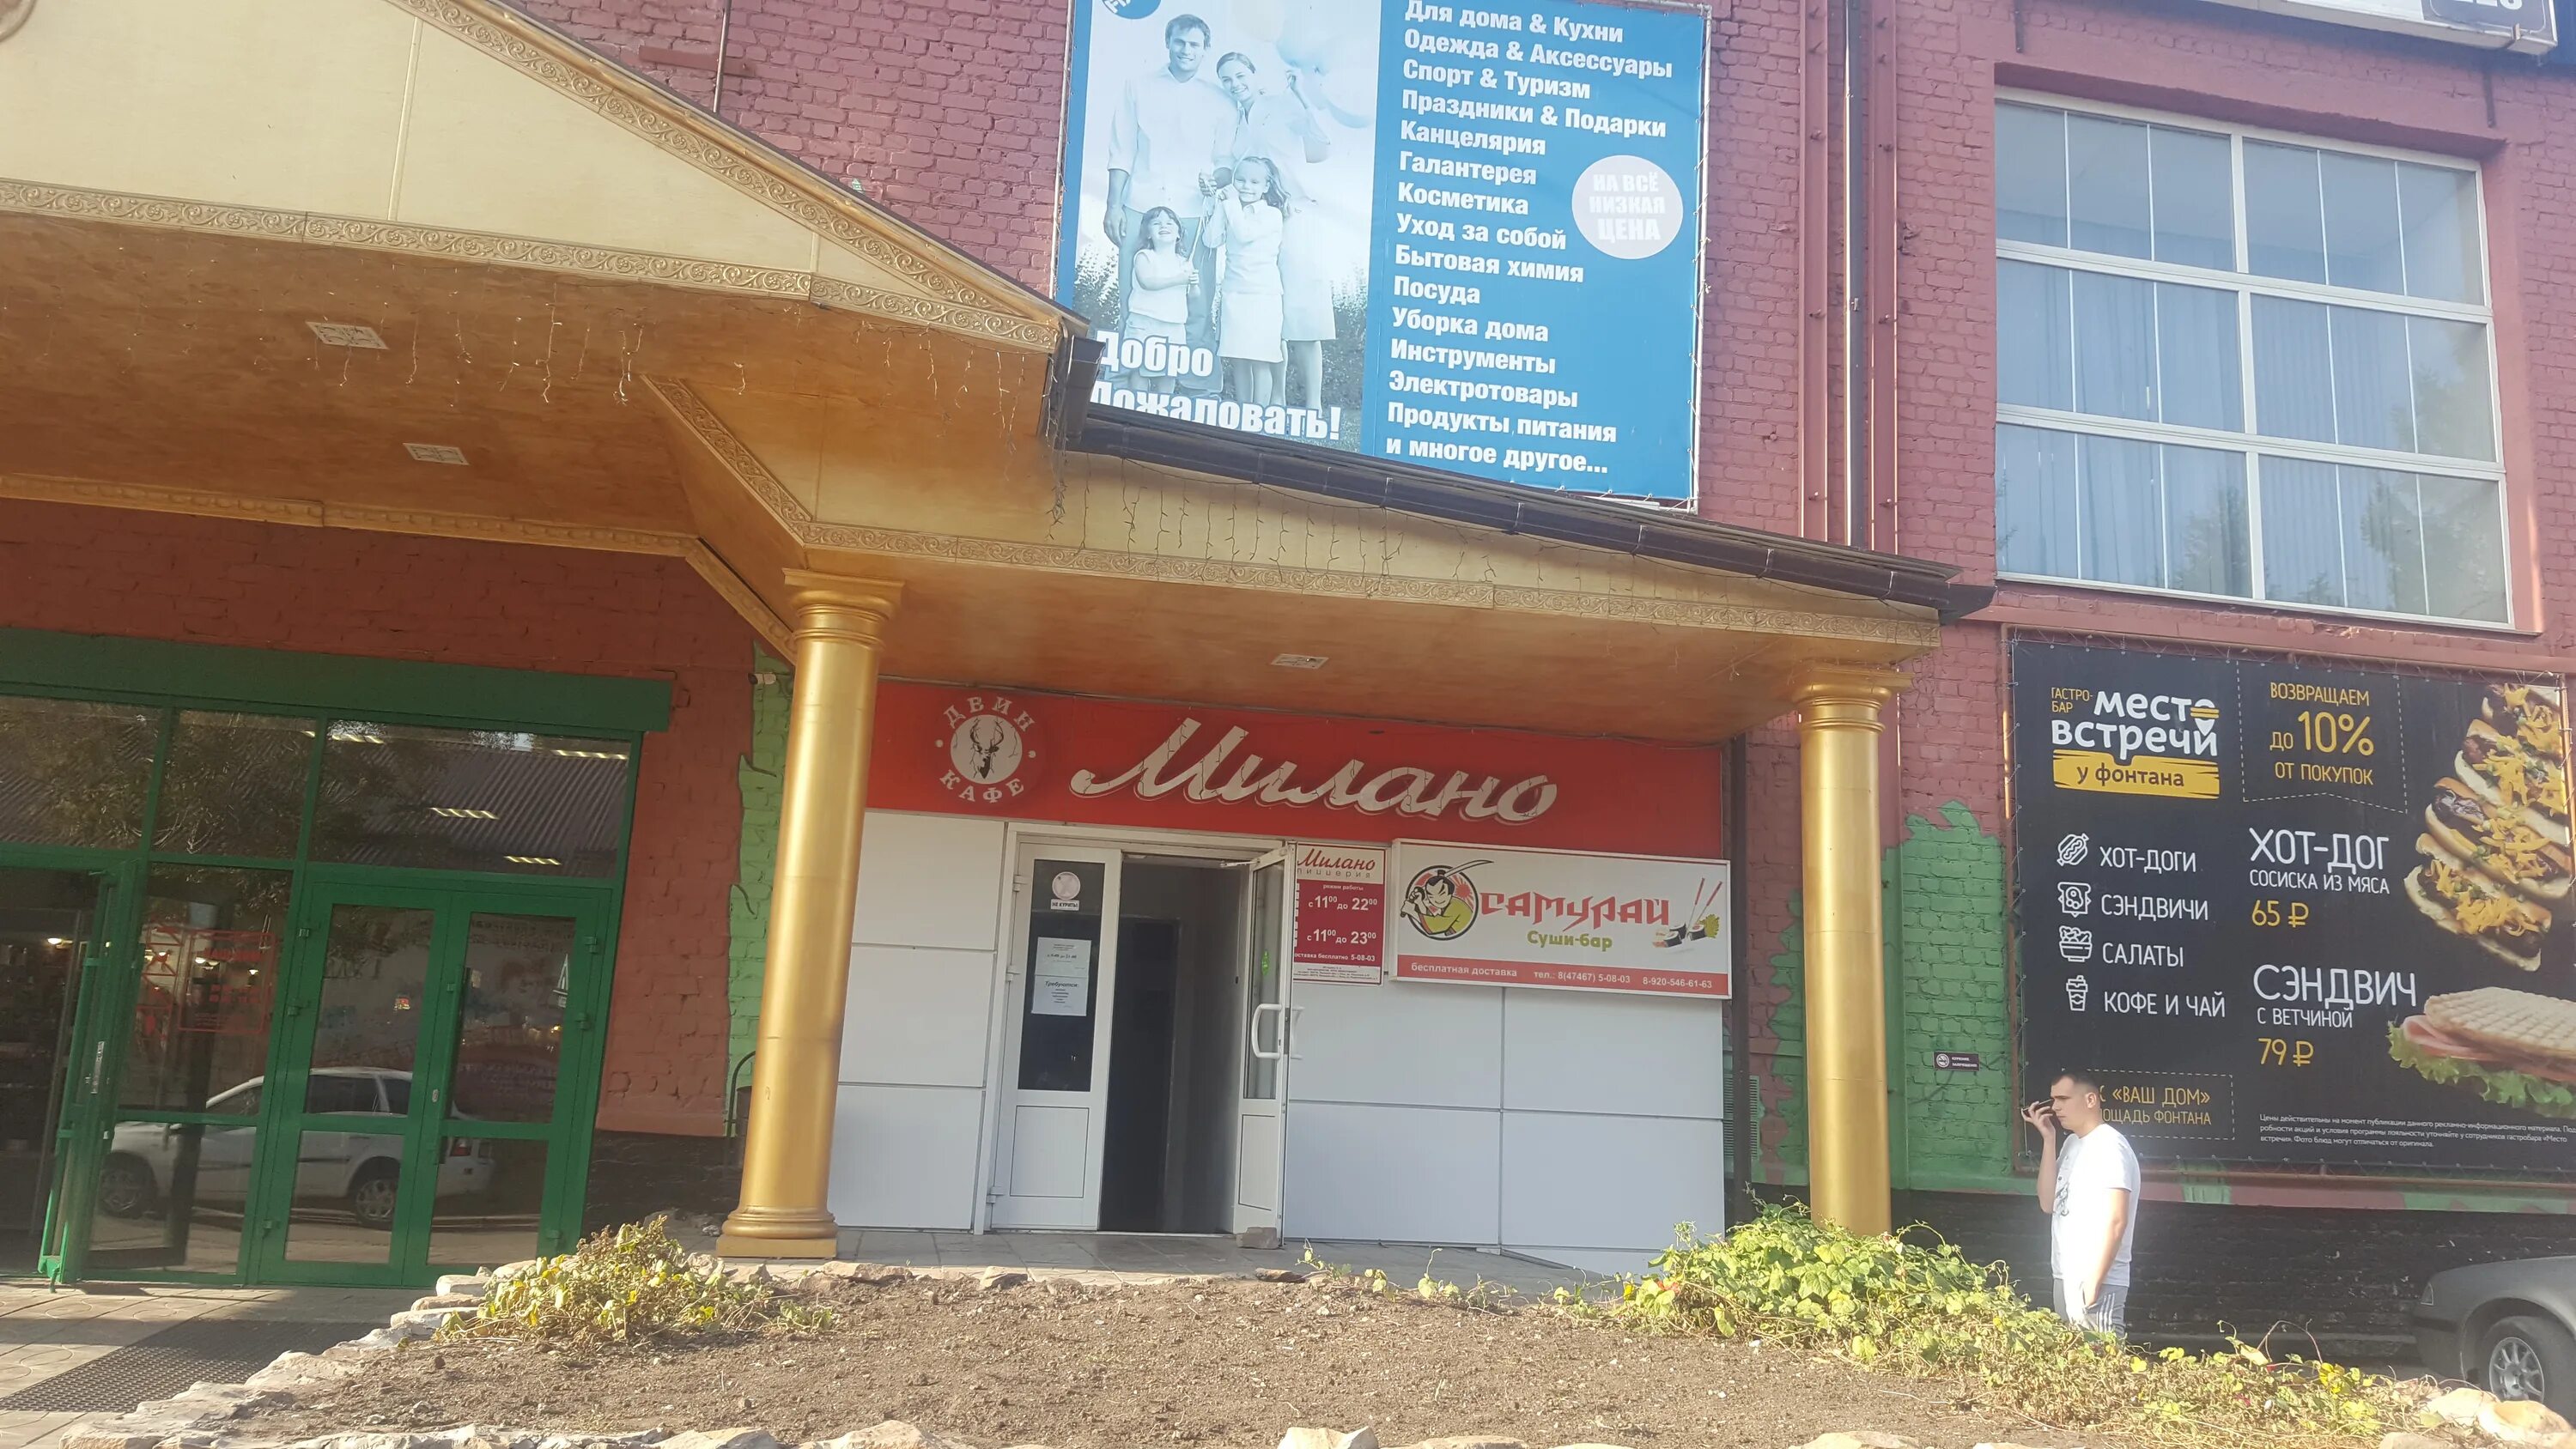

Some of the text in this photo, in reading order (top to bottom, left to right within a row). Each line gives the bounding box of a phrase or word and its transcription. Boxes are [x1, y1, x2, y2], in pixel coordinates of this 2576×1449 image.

[1406, 0, 1624, 43] Для дома & Кухни
[1404, 29, 1673, 79] Одежда & Аксессуары
[1403, 59, 1590, 99] Спорт & Туризм
[1402, 89, 1666, 137] Праздники & Подарки
[1400, 120, 1546, 155] Канцелярия
[1400, 151, 1537, 185] Галантерея
[1594, 171, 1659, 192] НА ВСЁ
[1398, 182, 1528, 215] Косметика
[1589, 196, 1666, 214] НИЗКАЯ
[1397, 213, 1566, 250] Уход за собой
[1598, 218, 1662, 244] ЦЕНА
[1395, 244, 1583, 283] Бытовая химия
[1394, 276, 1480, 306] Посуда
[1392, 306, 1549, 342] Уборка дома
[1096, 330, 1213, 378] Добро
[1390, 338, 1556, 374] Инструменты
[1388, 370, 1578, 409] Электротовары
[1388, 402, 1617, 443] Продукты питания
[1386, 438, 1608, 474] и многое другое...
[2051, 687, 2093, 701] ГАСТРО-
[2052, 700, 2073, 713] БАР
[2270, 682, 2370, 706] ВОЗВРАЩАЕМ
[943, 696, 1036, 732] ДВИН
[2051, 719, 2218, 760] встречи
[2298, 711, 2374, 756] 10%
[1070, 717, 1558, 824] Милано
[2076, 762, 2184, 786] у фонтана
[2275, 761, 2373, 785] ОТ ПОКУПОК
[939, 769, 1024, 803] КАФЕ
[1297, 848, 1376, 871] Милано
[2099, 846, 2196, 874] ХОТ-ДОГИ
[2249, 827, 2390, 875] ХОТ-ДОГ
[2250, 870, 2391, 894] СОСИСКА ИЗ МЯСА
[1479, 891, 1669, 932] САМУРАЙ
[2101, 894, 2208, 922] СЭНДВИЧИ
[2251, 900, 2281, 926] 65
[1527, 930, 1613, 952] Суши-бар
[2103, 943, 2184, 967] САЛАТЫ
[1411, 962, 1469, 974] бесплатная
[1472, 967, 1517, 977] доставка
[1558, 971, 1595, 983] 8(47467)
[1598, 973, 1631, 984] 5-08-03
[1643, 977, 1712, 988] 8-920-546-61-63
[2253, 964, 2416, 1010] СЭНДВИЧ
[2105, 991, 2226, 1017] КОФЕ И ЧАЙ
[2257, 1007, 2353, 1028] С ВЕТЧИНОЙ
[2258, 1038, 2287, 1065] 79
[2112, 1086, 2155, 1104] «ВАШ
[2162, 1088, 2210, 1108] ДОМ»
[2154, 1110, 2212, 1125] ФОНТАНА
[2259, 1113, 2279, 1122] Цены
[2280, 1115, 2330, 1124] действительны
[2314, 1136, 2332, 1144] блюд
[2426, 1131, 2458, 1139] уточняйте
